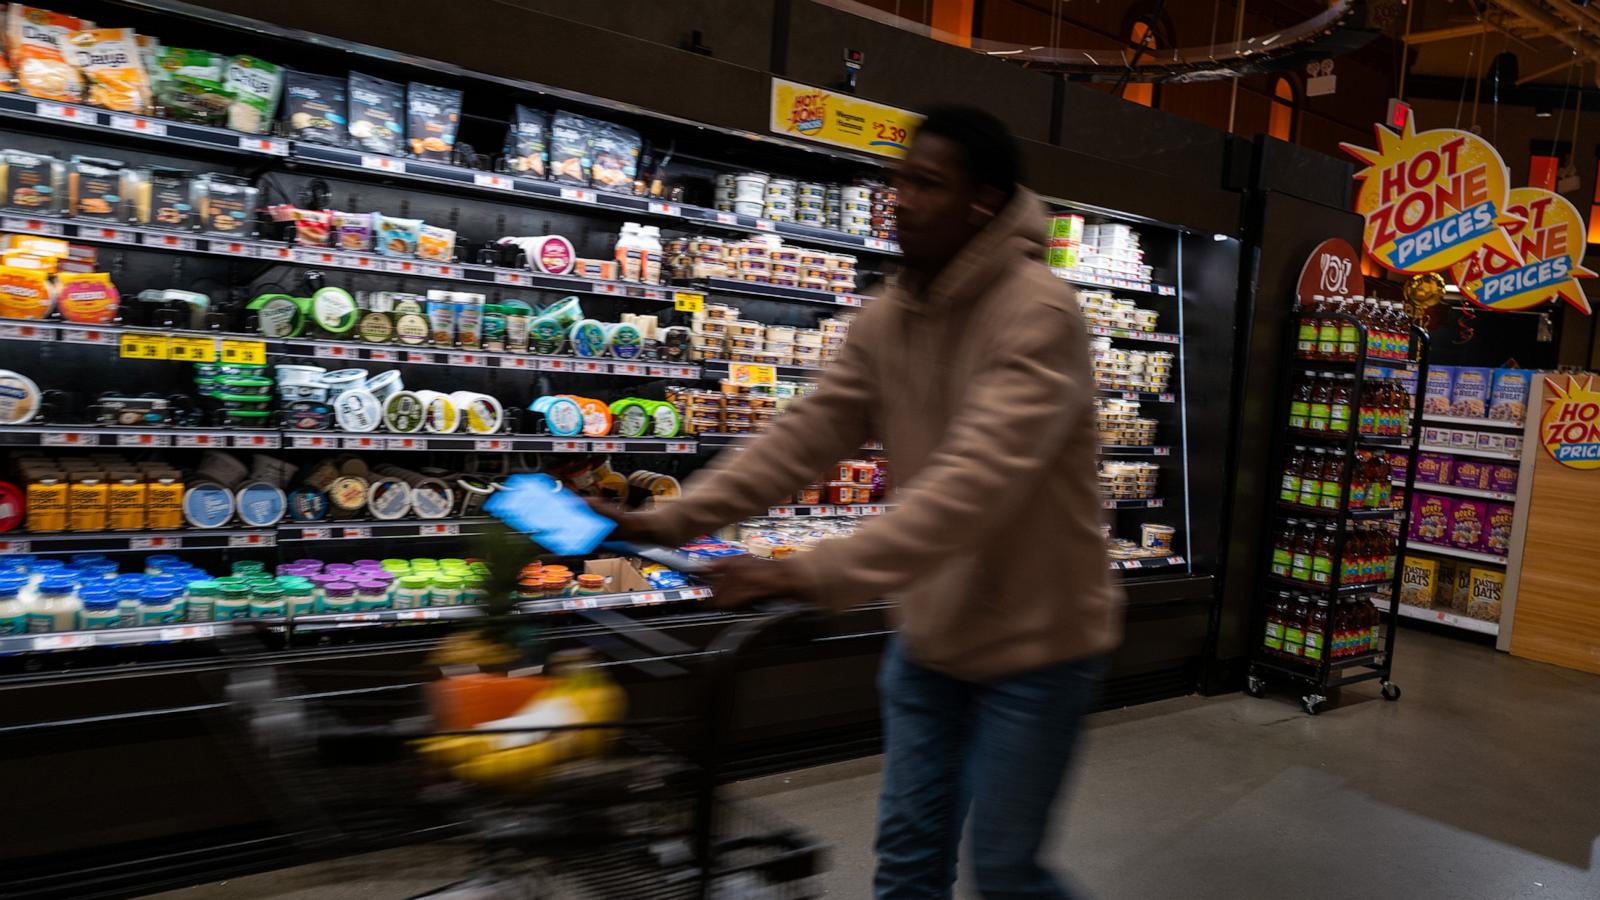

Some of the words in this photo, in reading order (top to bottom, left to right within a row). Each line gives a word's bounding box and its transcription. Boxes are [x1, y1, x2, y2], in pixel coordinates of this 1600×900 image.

[76, 51, 129, 67] Daiya
[794, 94, 819, 108] HOT
[789, 106, 824, 123] ZONE
[872, 121, 907, 143] $2.39
[1381, 137, 1465, 205] HOT
[1369, 163, 1488, 252] ZONE
[1398, 203, 1492, 264] PRICES
[1484, 257, 1568, 300] PRICES
[1559, 403, 1600, 422] HO
[1548, 422, 1600, 444] ZON
[1560, 445, 1600, 458] PRIC
[1403, 572, 1429, 587] OATS
[1473, 585, 1501, 601] OATS
